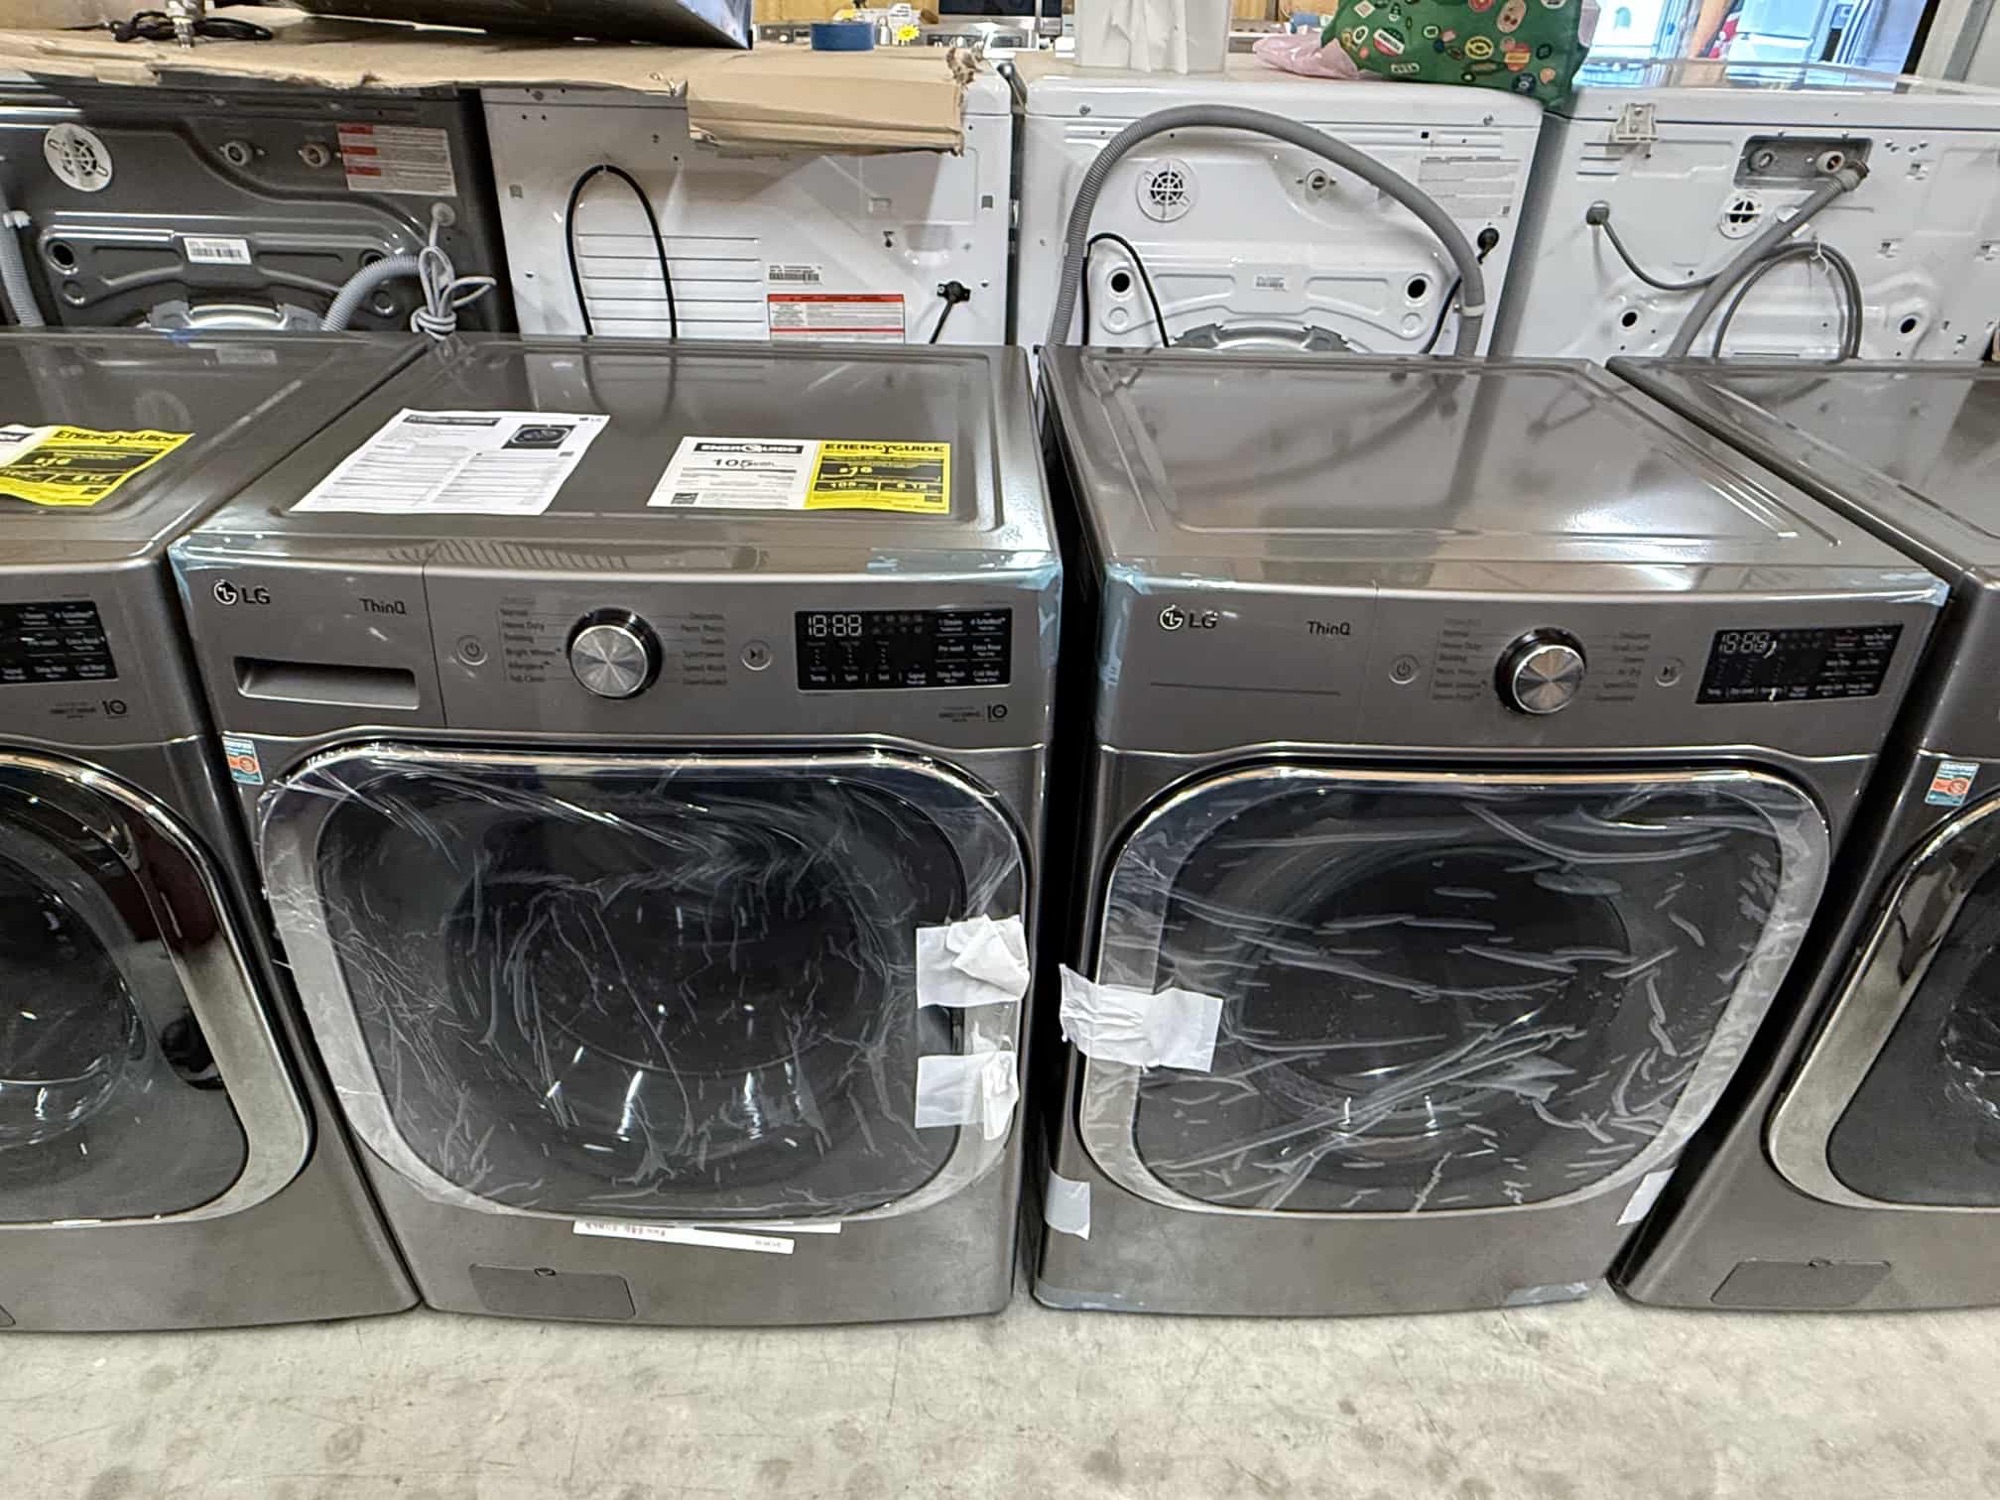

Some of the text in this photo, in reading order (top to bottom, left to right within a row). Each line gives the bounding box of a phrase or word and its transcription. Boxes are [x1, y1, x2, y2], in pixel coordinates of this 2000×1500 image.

[241, 587, 271, 605] LG
[359, 597, 407, 615] ThinQ
[1189, 610, 1218, 629] LG
[1307, 620, 1351, 636] ThinQ
